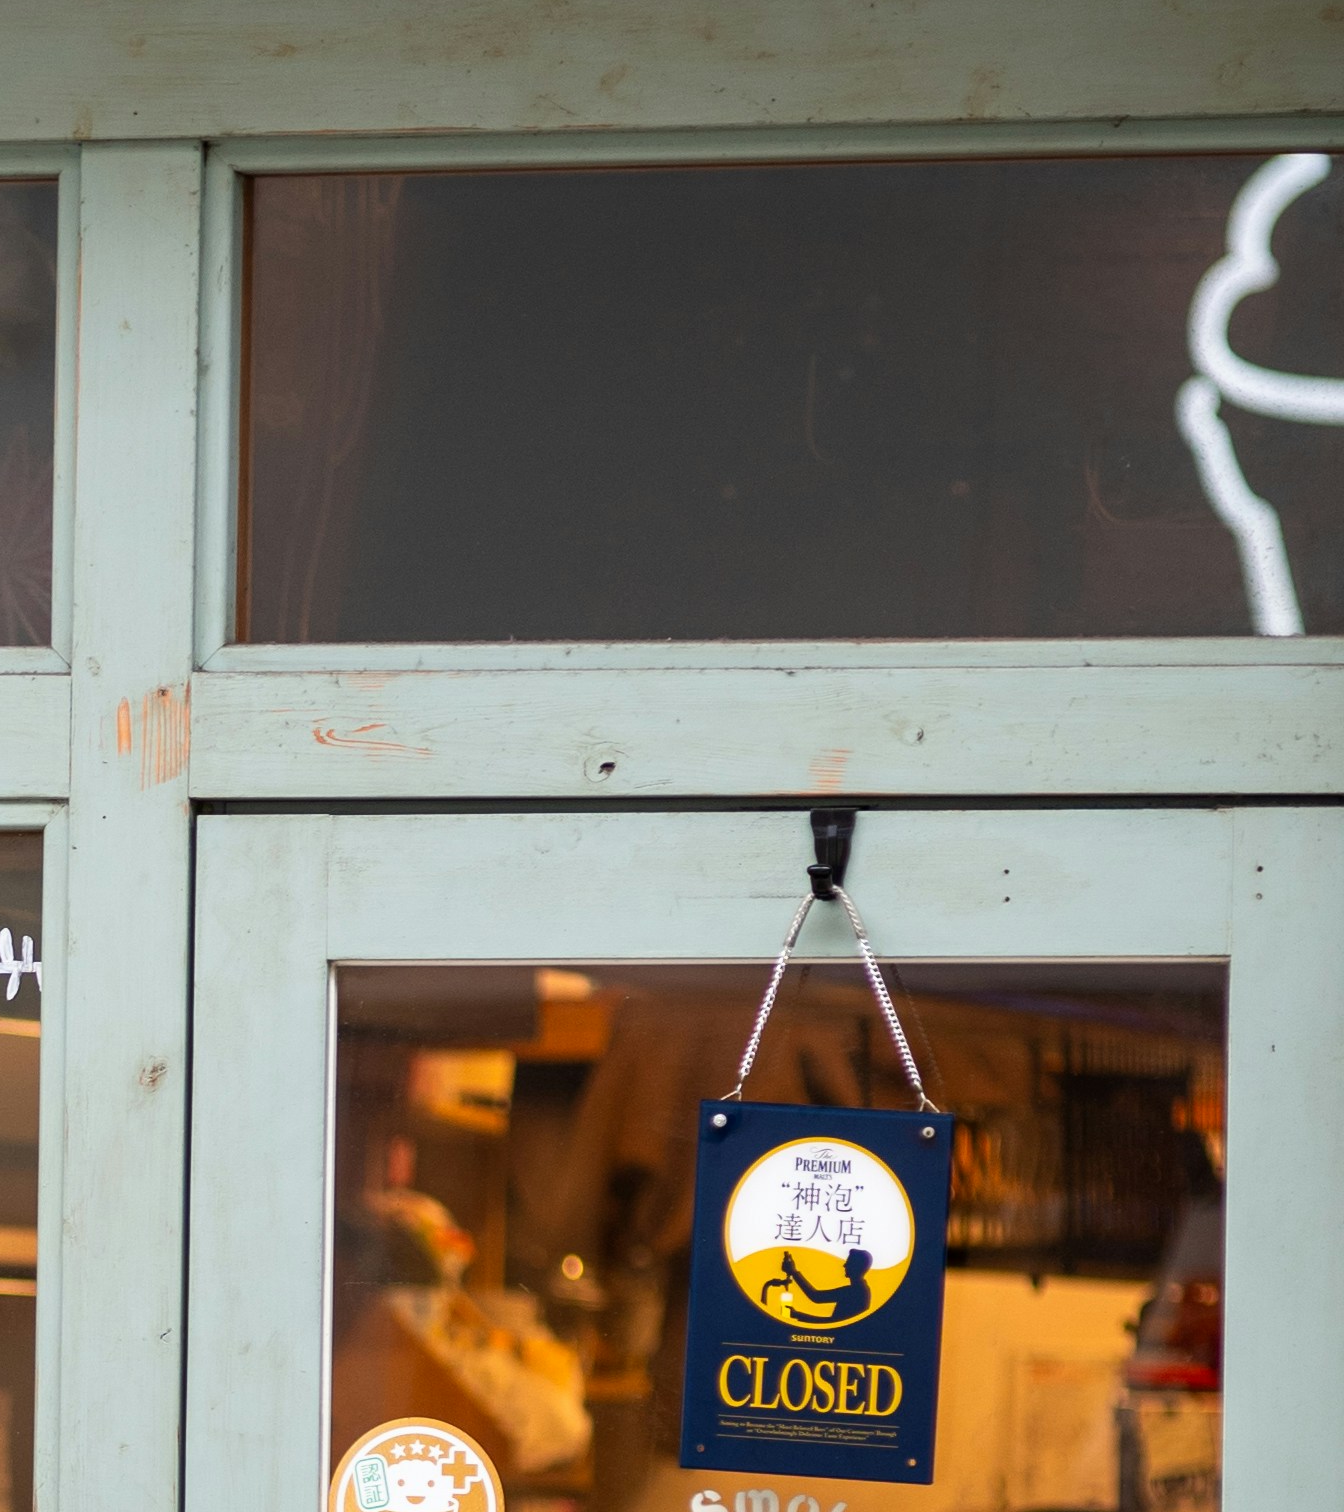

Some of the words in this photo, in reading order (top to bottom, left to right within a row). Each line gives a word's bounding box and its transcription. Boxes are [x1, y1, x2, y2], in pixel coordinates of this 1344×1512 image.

[795, 1157, 852, 1174] PREMIUM
[775, 1213, 865, 1245] 達人店
[719, 1354, 903, 1416] CLOSED
